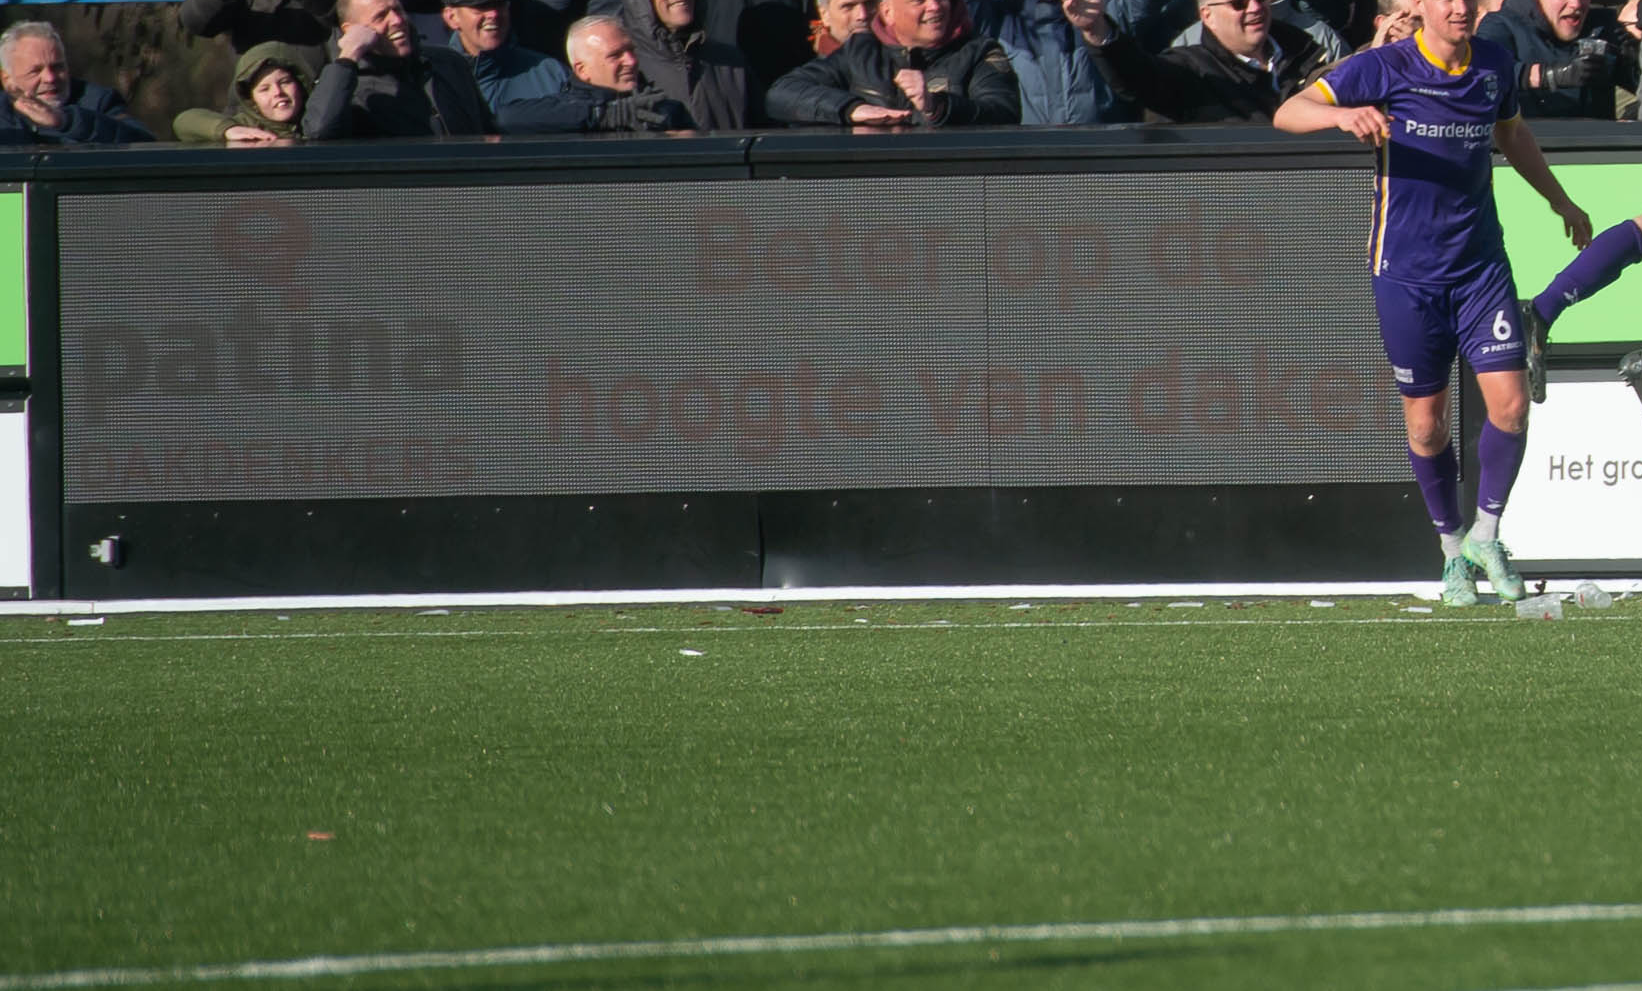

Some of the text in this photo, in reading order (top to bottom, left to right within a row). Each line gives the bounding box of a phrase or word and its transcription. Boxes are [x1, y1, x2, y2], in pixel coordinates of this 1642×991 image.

[695, 200, 1270, 312] Beter op de
[81, 296, 467, 424] patina
[1492, 309, 1512, 341] 6
[545, 355, 883, 460] hoogte
[917, 362, 1089, 437] van
[1548, 453, 1594, 482] Het
